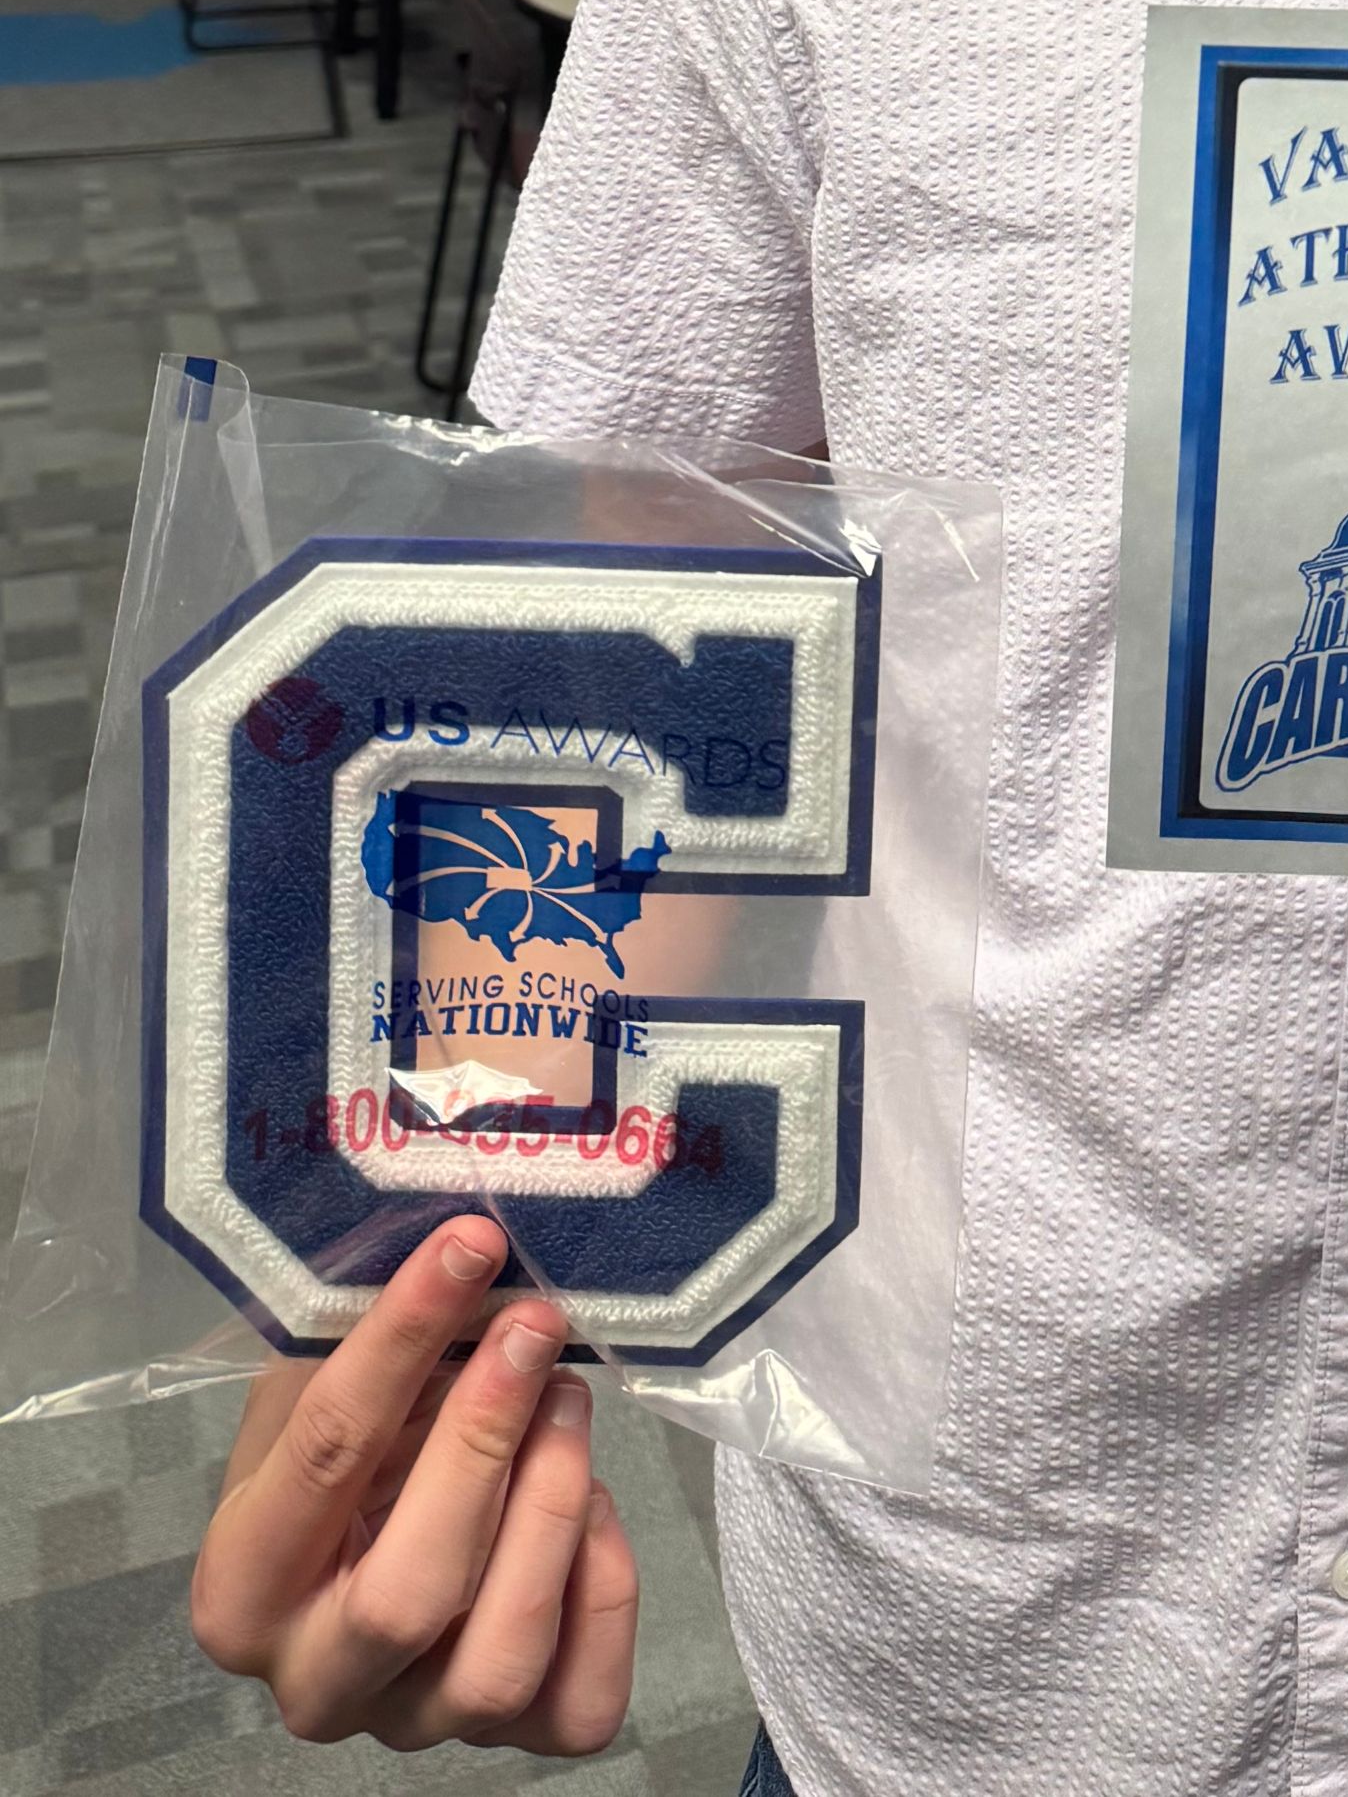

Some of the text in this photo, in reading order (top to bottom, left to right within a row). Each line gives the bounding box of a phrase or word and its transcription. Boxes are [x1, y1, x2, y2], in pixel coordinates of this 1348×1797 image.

[373, 697, 787, 791] US AWARDS
[372, 970, 649, 1023] SERVING SCHOOLS
[369, 1002, 649, 1058] NATIONWIDE
